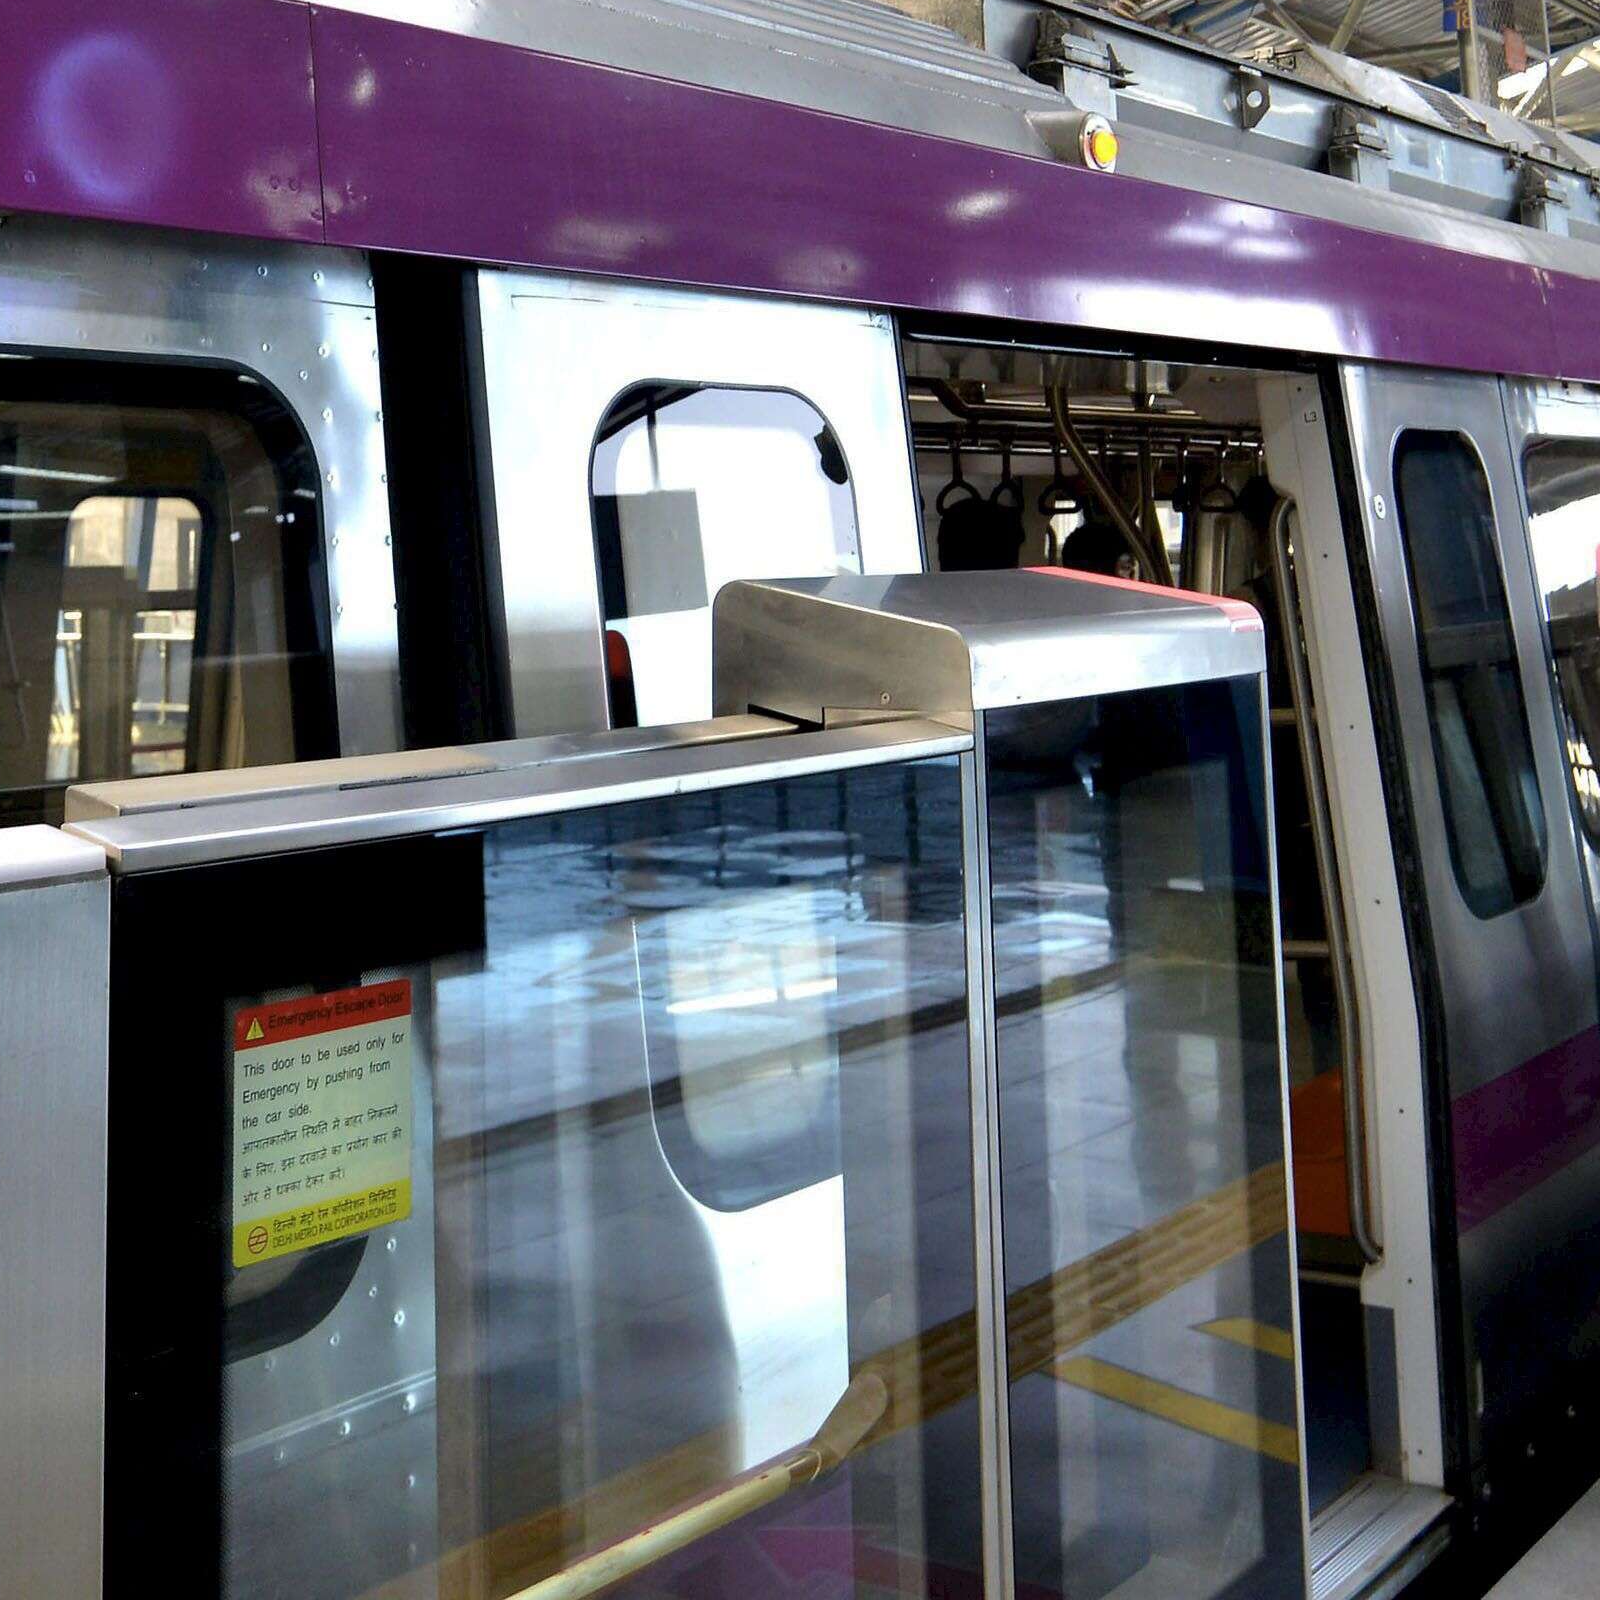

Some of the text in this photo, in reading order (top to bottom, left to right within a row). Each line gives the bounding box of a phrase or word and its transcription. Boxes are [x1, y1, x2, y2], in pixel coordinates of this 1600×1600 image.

[268, 1006, 334, 1028] Emergency
[334, 998, 376, 1015] Escape
[243, 1032, 405, 1077] This door to be used only for
[243, 1060, 391, 1104] Emergency by pushing from
[242, 1103, 312, 1130] the car side.
